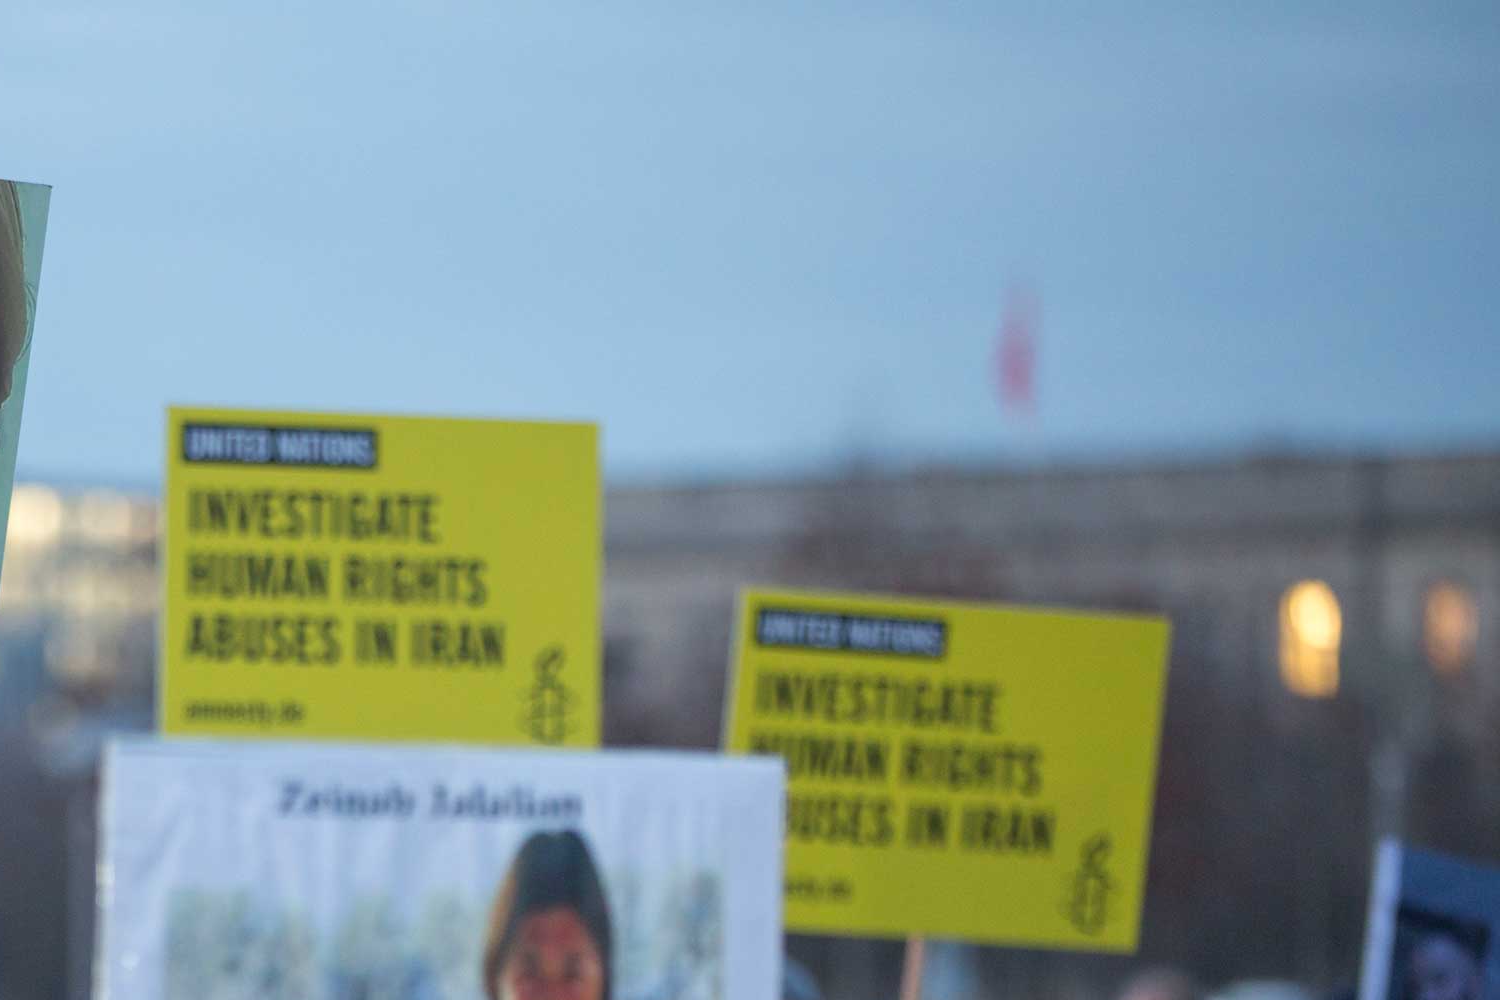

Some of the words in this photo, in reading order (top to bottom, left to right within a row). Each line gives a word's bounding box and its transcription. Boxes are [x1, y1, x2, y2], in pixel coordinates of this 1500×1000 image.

[187, 427, 270, 462] UNITED
[279, 431, 371, 466] NATIONS
[188, 489, 440, 542] INVESTIGATE
[186, 553, 328, 598] HUMAN
[342, 556, 489, 607] RIGHTS
[185, 615, 339, 665] ABUSES
[354, 620, 396, 666] IN
[410, 622, 506, 668] IRAN
[756, 672, 999, 733] INVESTIGATE
[901, 741, 1042, 796] RIGHTS
[906, 803, 948, 850] IN
[961, 806, 1055, 854] IRAN
